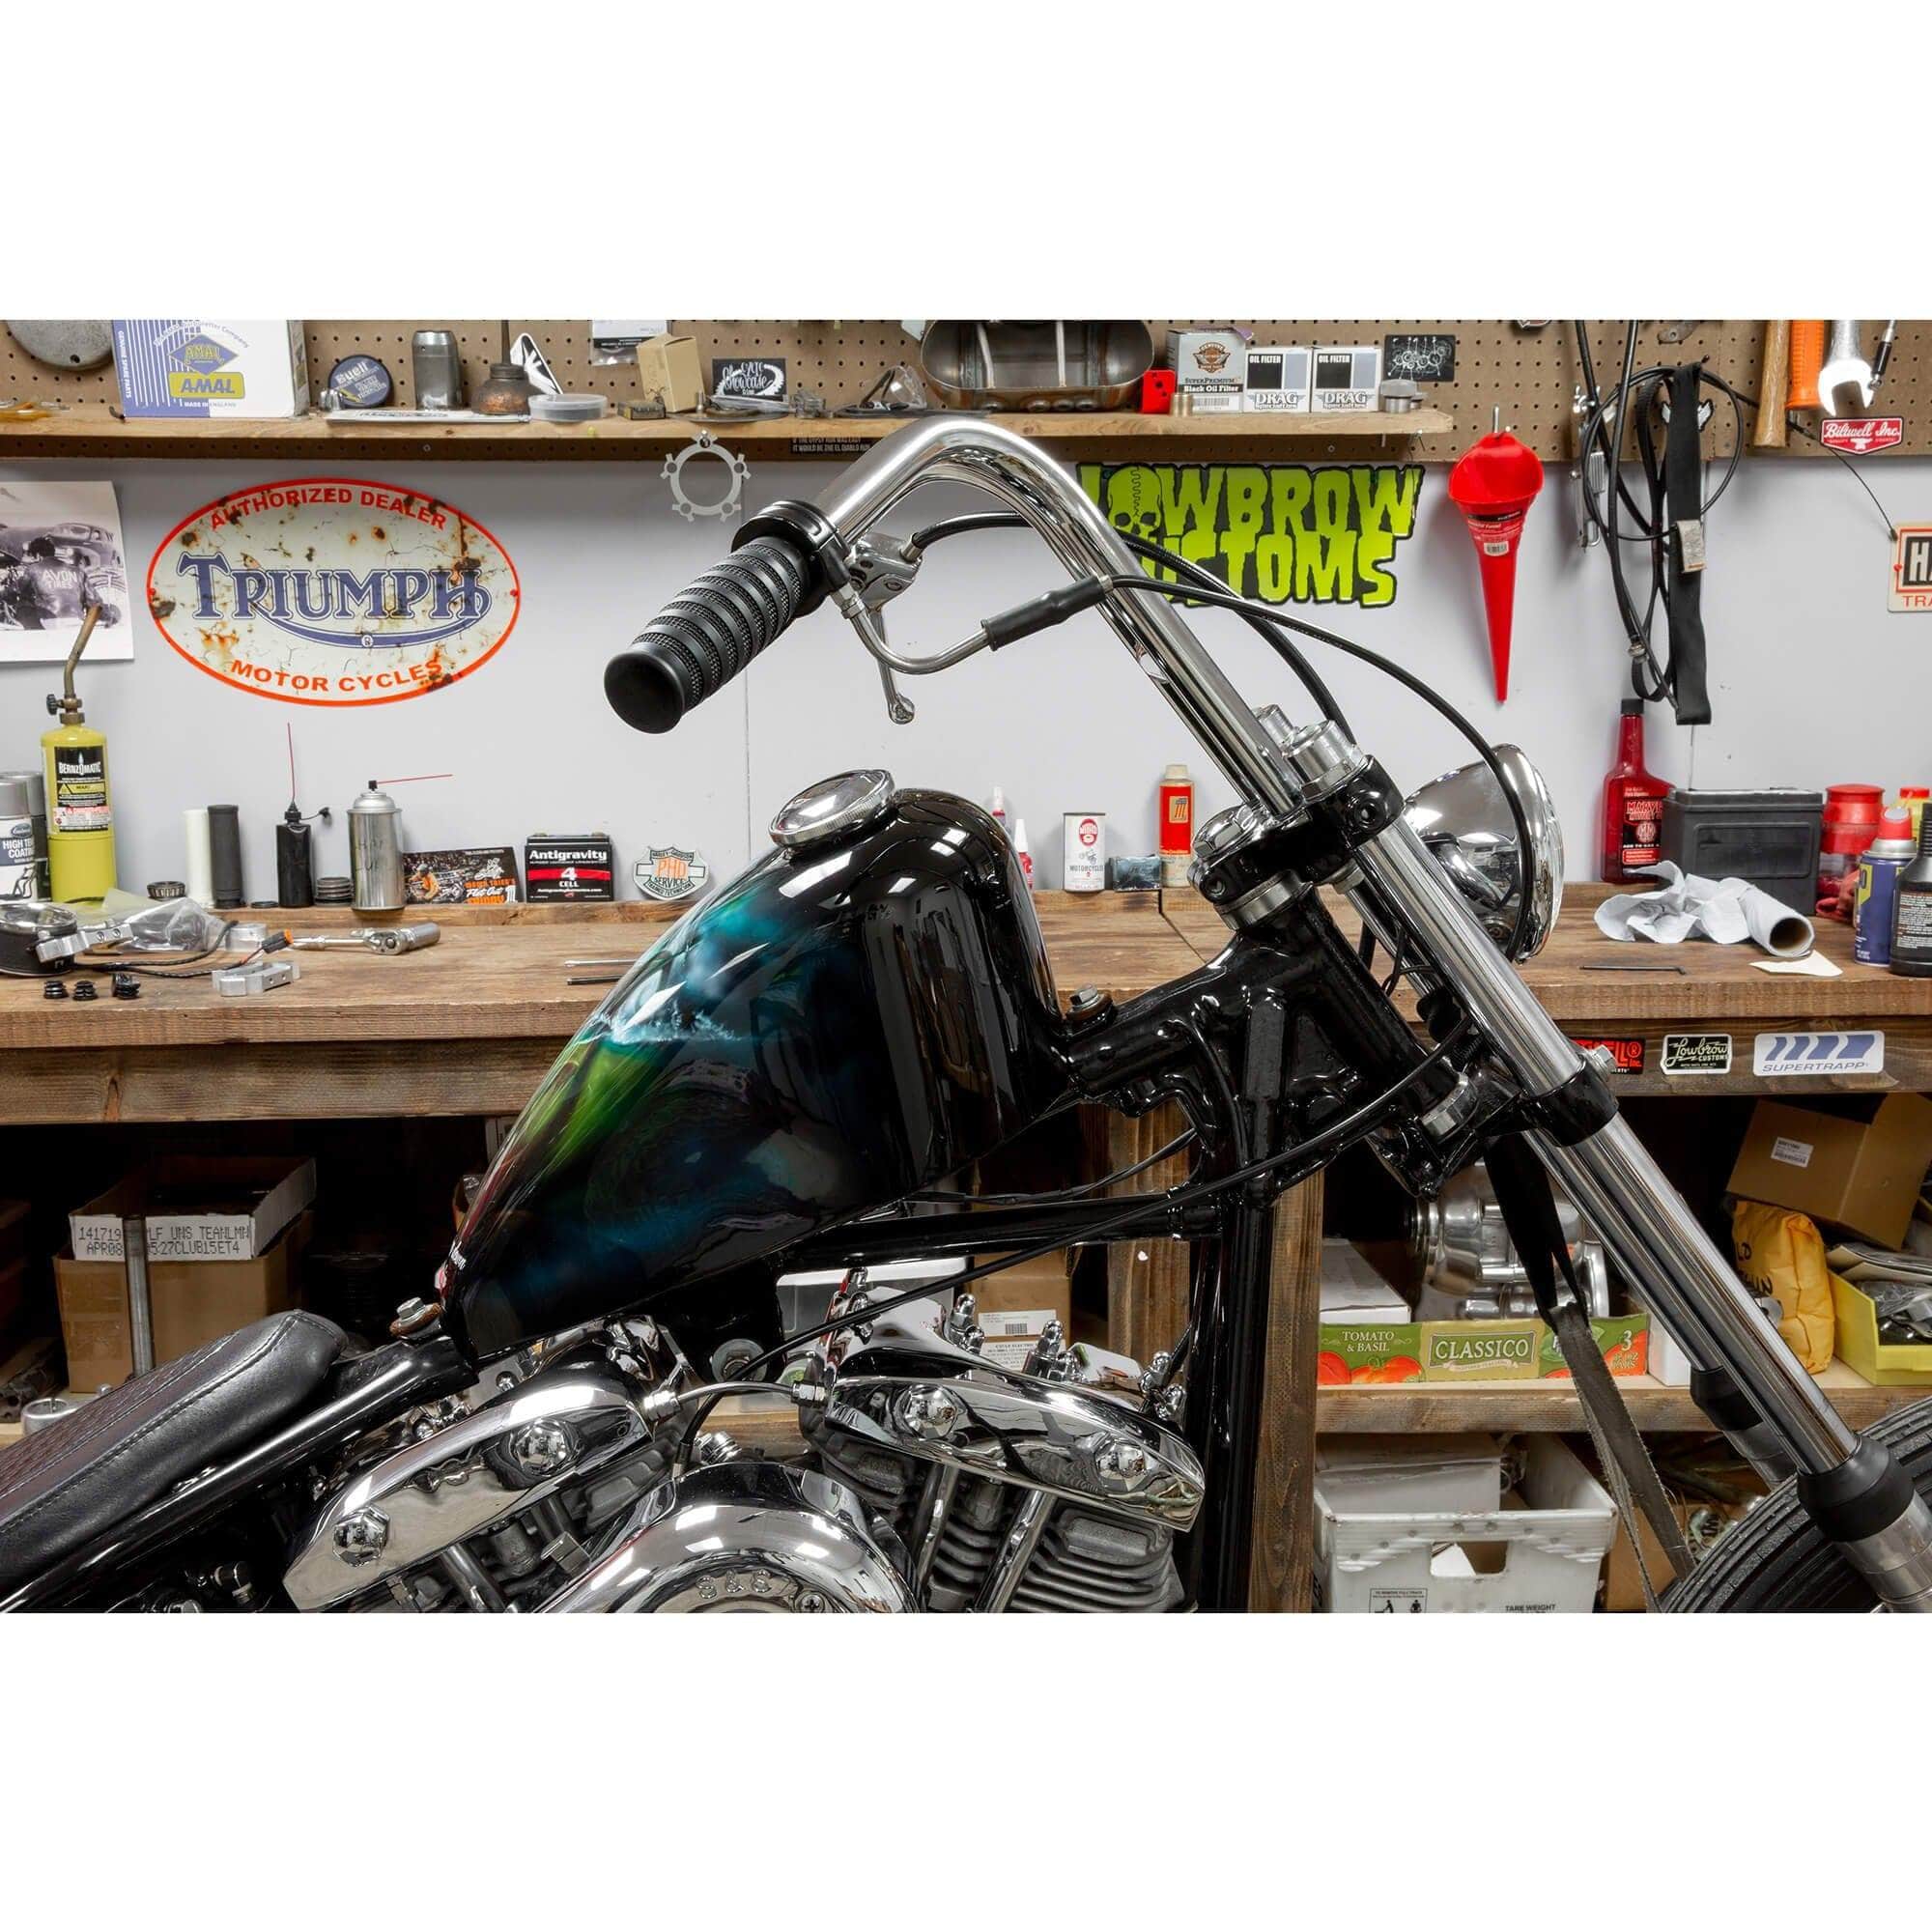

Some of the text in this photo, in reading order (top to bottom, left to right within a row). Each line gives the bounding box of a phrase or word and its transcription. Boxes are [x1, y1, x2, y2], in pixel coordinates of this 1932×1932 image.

[1319, 355, 1350, 363] OIL FILTER
[334, 361, 368, 384] Buell
[182, 378, 235, 394] AMAL
[1255, 391, 1298, 404] DRAG
[1323, 391, 1367, 404] DRAG
[1824, 421, 1900, 438] Biltwell Inc.
[210, 488, 448, 530] AUTHORIZED DEALER
[43, 569, 78, 583] AVON
[175, 552, 494, 620] TRIUMPH
[230, 659, 444, 693] MOTOR CYCLES
[2, 838, 23, 849] HIGH
[528, 849, 608, 862] Antigravity
[560, 867, 578, 881] 4
[1663, 1037, 1728, 1066] Lowbrow
[1761, 1060, 1865, 1072] SUPERTRAPP
[1342, 1330, 1395, 1343] TOMATO
[1621, 1329, 1633, 1351] 3
[1346, 1342, 1390, 1352] & BASIL
[1435, 1338, 1529, 1360] CLASSICO
[1525, 1604, 1556, 1612] WEIGHT
